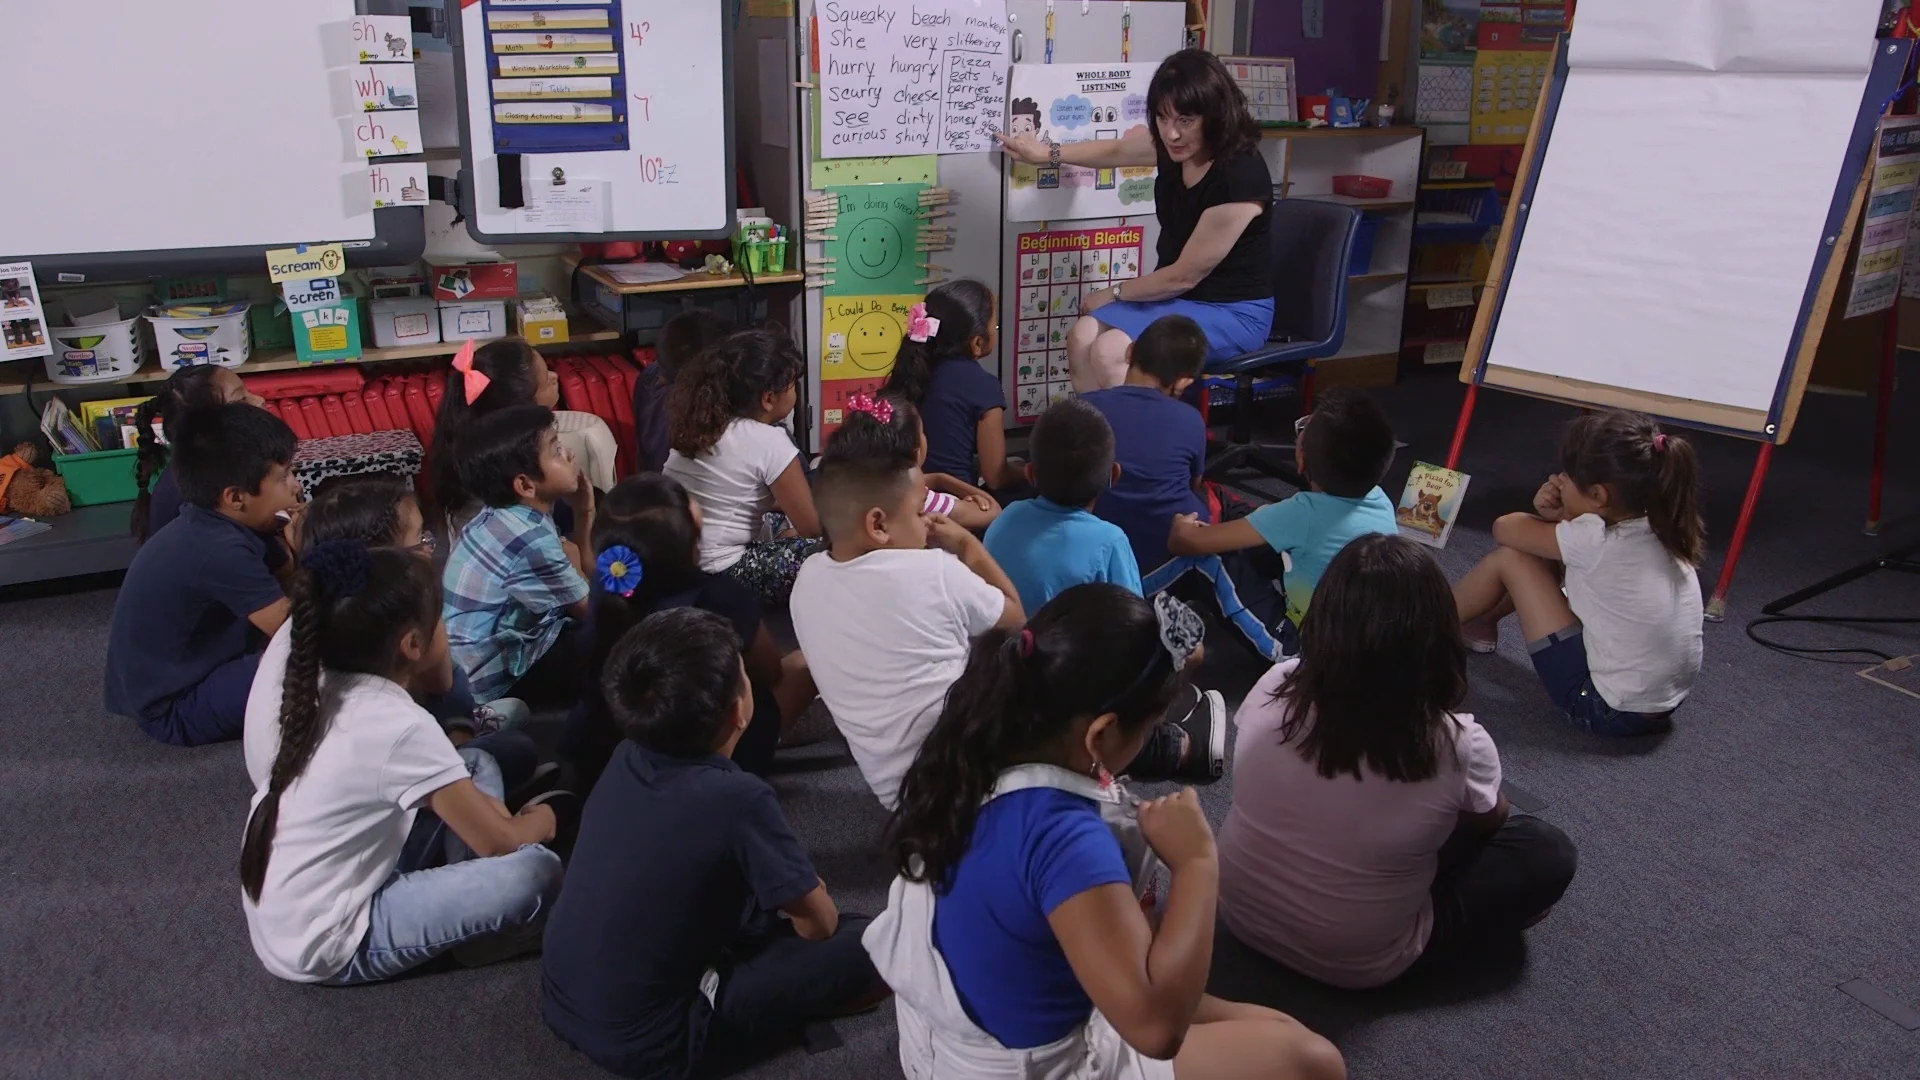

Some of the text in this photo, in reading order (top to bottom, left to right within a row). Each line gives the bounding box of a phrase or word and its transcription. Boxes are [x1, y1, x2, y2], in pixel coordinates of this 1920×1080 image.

[826, 2, 1006, 35] Squeaky beach monkeys
[352, 17, 376, 42] sh
[830, 29, 1002, 59] She very slithering
[828, 54, 939, 85] hurry hungry
[950, 68, 980, 82] eats
[1076, 70, 1131, 80] WHOLE BODY
[355, 67, 385, 97] wh
[1081, 82, 1127, 92] LISTENING
[829, 85, 940, 108] scurry cheese
[946, 96, 976, 110] trees
[505, 112, 563, 120] Closing Activities
[896, 108, 934, 131] dirty
[945, 112, 977, 129] honey
[357, 114, 384, 141] ch
[945, 125, 970, 140] bees
[832, 129, 930, 147] curious shiny
[369, 167, 389, 192] th
[864, 192, 888, 212] doing
[1020, 230, 1140, 252] Beginning Blends
[1031, 255, 1040, 266] bl
[1062, 252, 1070, 263] cl
[1093, 250, 1100, 261] fl
[1122, 249, 1129, 264] gl
[271, 260, 321, 275] scream
[290, 290, 334, 304] screen
[1030, 288, 1039, 303] pl
[1062, 285, 1069, 296] sl
[839, 302, 864, 317] Could
[871, 300, 882, 311] Do
[891, 302, 910, 316] Bette
[1028, 320, 1039, 331] dr
[1060, 317, 1068, 328] fr
[1028, 355, 1036, 364] tr
[1027, 387, 1037, 398] sp
[1059, 382, 1067, 391] st
[1424, 473, 1443, 483] Pizza
[1443, 478, 1453, 488] for
[1425, 481, 1442, 490] Bear
